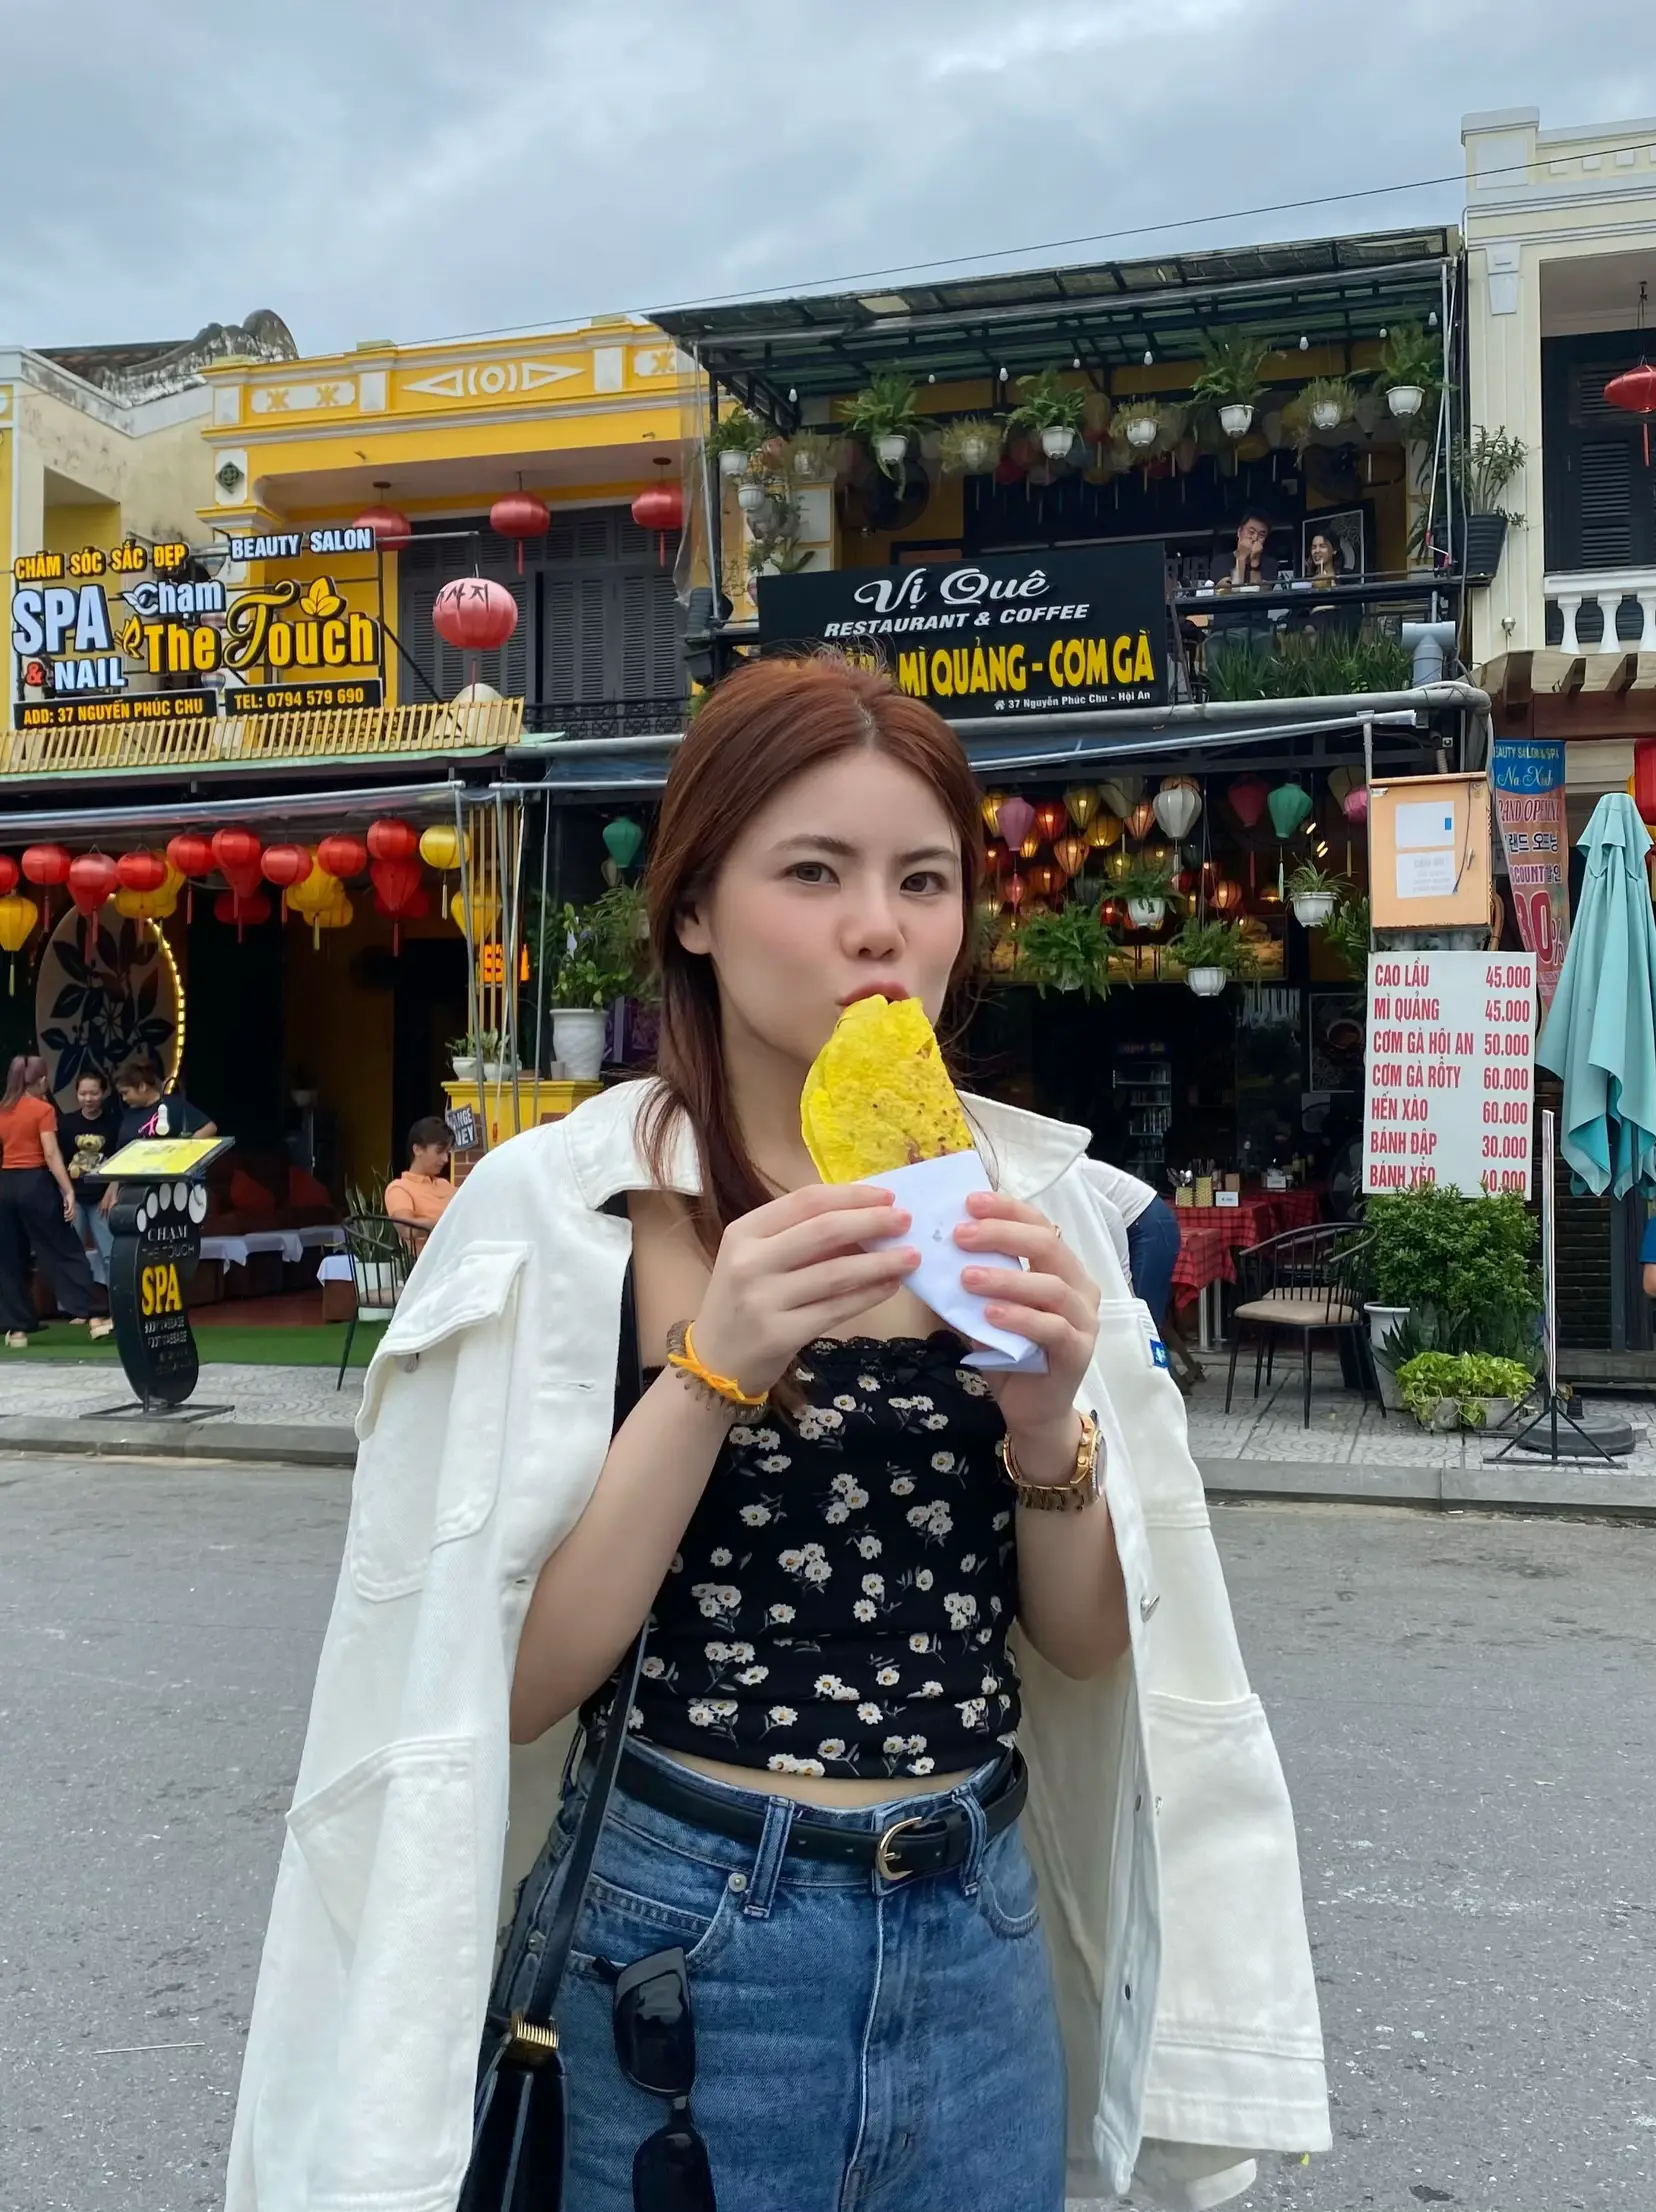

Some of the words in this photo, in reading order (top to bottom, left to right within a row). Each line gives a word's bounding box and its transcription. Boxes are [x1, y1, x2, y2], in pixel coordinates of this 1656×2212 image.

[16, 552, 61, 580] CHĂM
[70, 546, 102, 575] SÓC
[111, 541, 143, 571] SẮC
[154, 543, 186, 571] ĐẸP
[232, 534, 299, 559] BEAUTY
[310, 529, 371, 552] SALON
[123, 581, 222, 619] Chạm
[854, 567, 927, 613] Vị
[939, 567, 1050, 605] Quê
[13, 584, 110, 655] SPA
[144, 623, 216, 673] The
[224, 579, 374, 669] Touch
[824, 613, 970, 638] RESTAURANT
[973, 611, 991, 627] &
[1000, 603, 1090, 625] COFFEE
[25, 661, 46, 686] &
[55, 657, 126, 690] NAIL
[899, 645, 929, 698] MÌ
[931, 636, 1027, 697] QUẢNG
[1049, 638, 1109, 688] CƠM
[1112, 629, 1155, 684] GÀ
[24, 708, 54, 725] ADD:
[57, 707, 74, 723] 37
[78, 698, 130, 721] NGUYỄN
[133, 697, 171, 718] PHÚC
[175, 697, 203, 715] CHU
[234, 693, 263, 709] TEL:
[267, 691, 302, 708] 0794
[306, 689, 333, 705] 579
[337, 687, 364, 704] 690
[1008, 699, 1020, 709] 37
[1062, 694, 1086, 706] Phúc
[1089, 693, 1108, 703] Chu
[1137, 690, 1151, 700] An
[1375, 963, 1401, 987] CAO
[1404, 956, 1430, 988] LẦU
[1485, 965, 1531, 989] 45.000
[1374, 992, 1391, 1020] MÌ
[1394, 990, 1440, 1023] QUẢNG
[1485, 999, 1530, 1023] 45.000
[1373, 1028, 1403, 1054] CƠM
[1407, 1026, 1425, 1055] GÀ
[1455, 1032, 1475, 1055] AN
[1484, 1033, 1530, 1056] 50.000
[1372, 1062, 1403, 1088] CƠM
[1406, 1059, 1425, 1088] GÀ
[1483, 1067, 1529, 1091] 60.000
[1371, 1090, 1398, 1121] HẾN
[1402, 1093, 1429, 1122] XÀO
[1482, 1100, 1528, 1125] 60.000
[1370, 1126, 1407, 1154] BÁNH
[1482, 1135, 1527, 1159] 30.000
[1369, 1160, 1406, 1188] BÁNH
[142, 1263, 183, 1316] SPA
